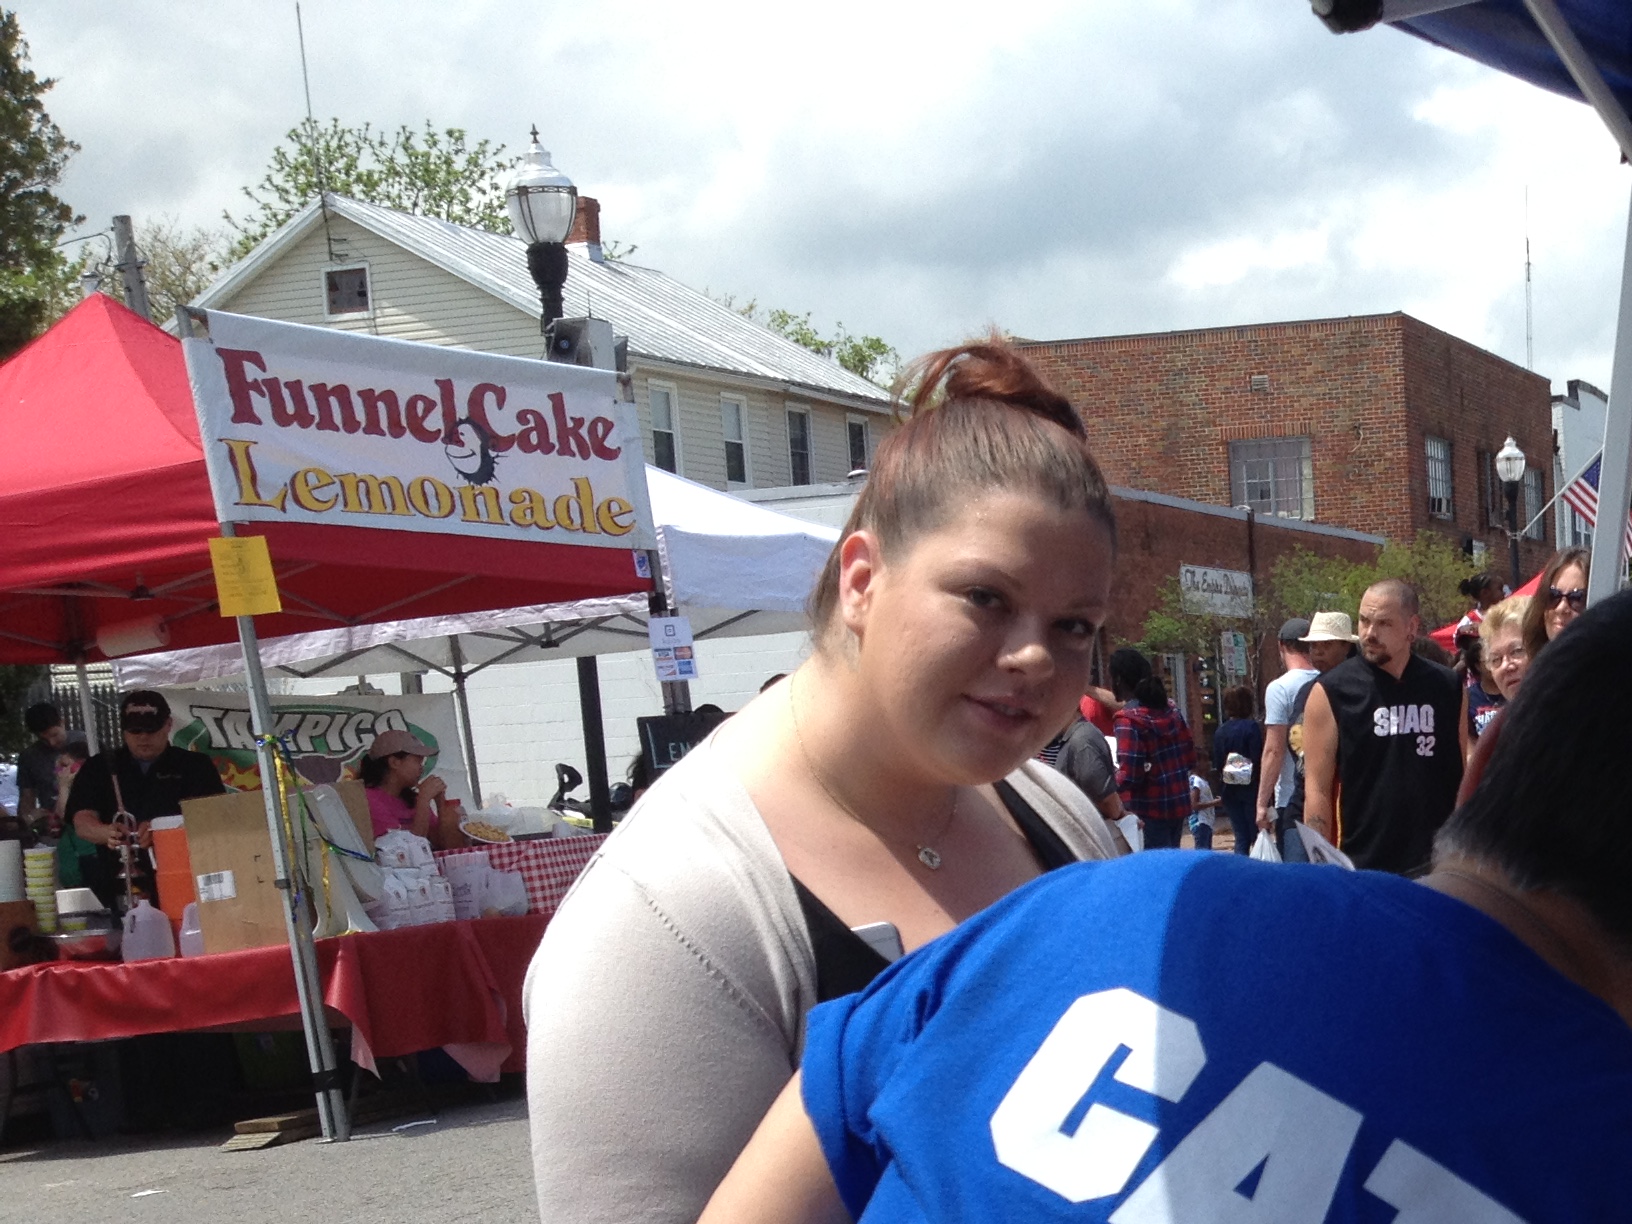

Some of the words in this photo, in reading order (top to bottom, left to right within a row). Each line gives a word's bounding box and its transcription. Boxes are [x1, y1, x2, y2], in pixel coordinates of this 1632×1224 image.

[216, 347, 465, 447] Funnel
[467, 382, 621, 461] Cake
[218, 438, 636, 537] Lemonade
[1373, 704, 1434, 737] SHAQ
[1416, 735, 1436, 757] 32
